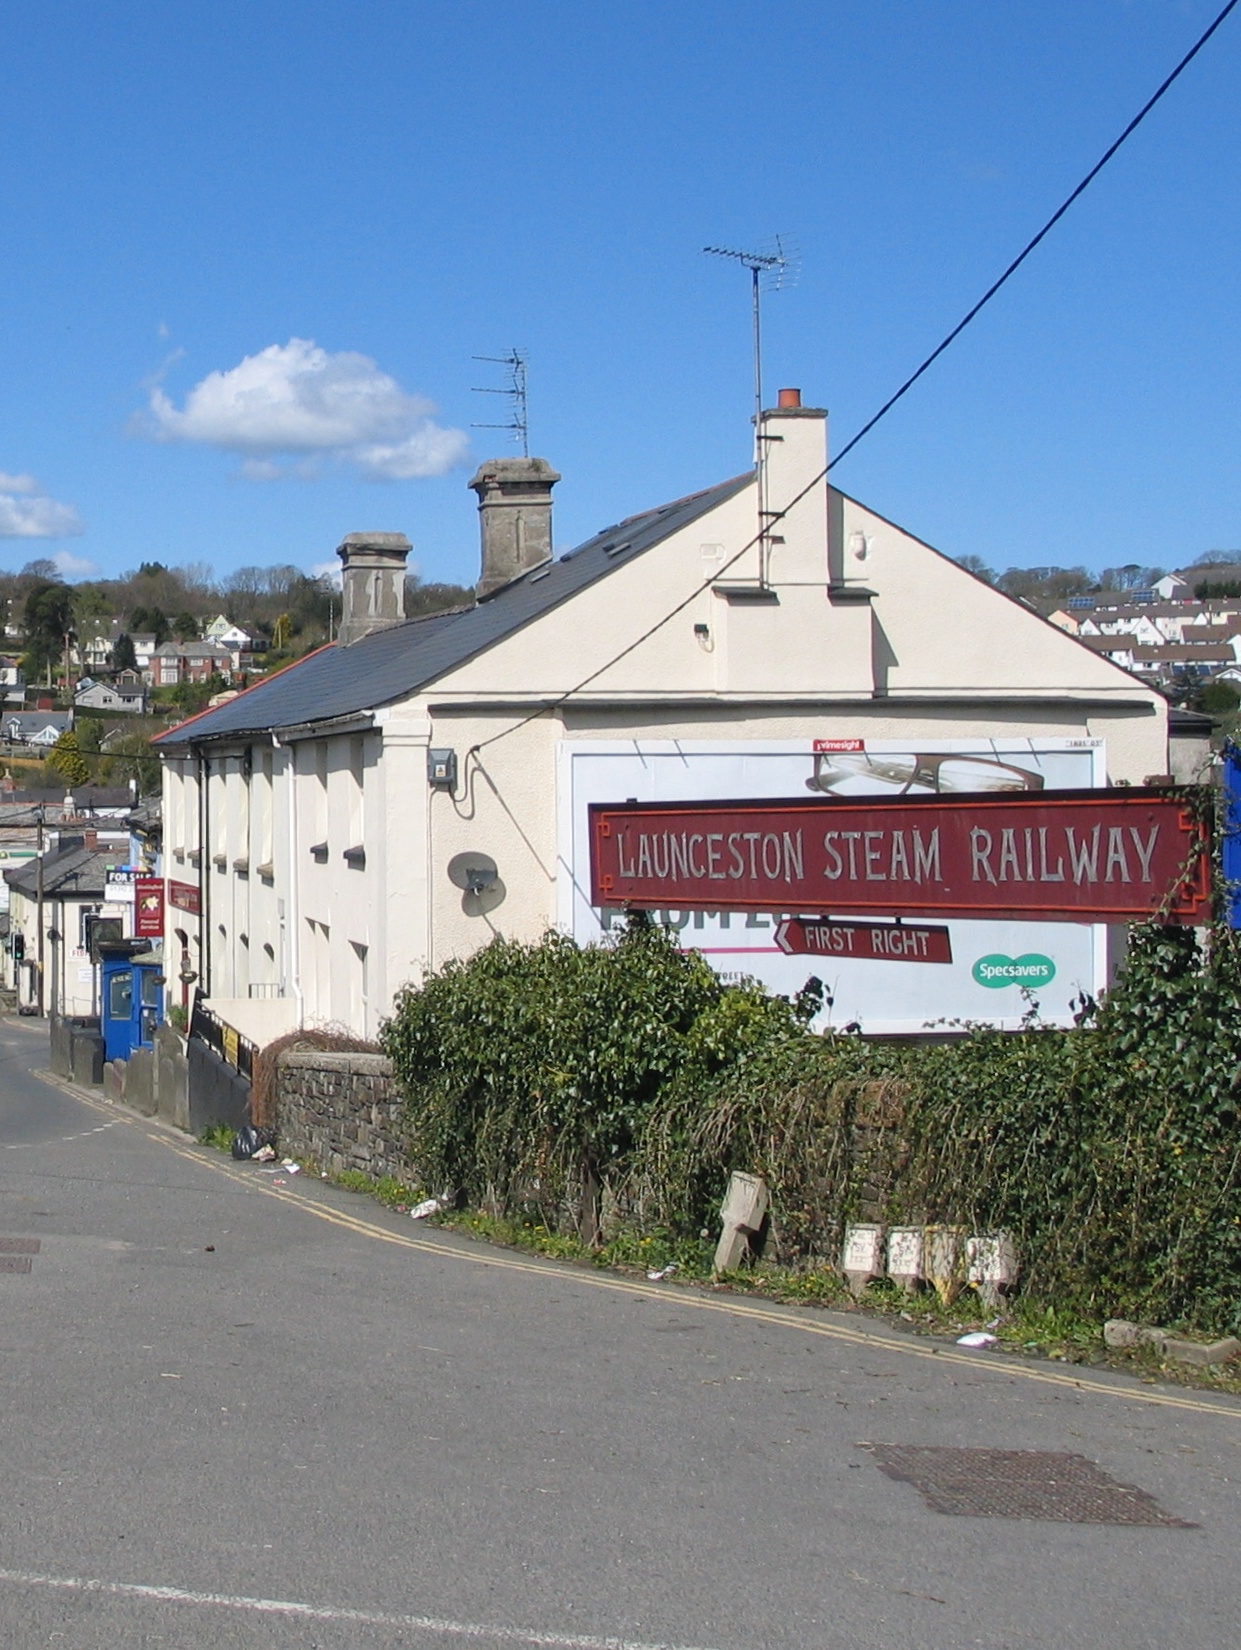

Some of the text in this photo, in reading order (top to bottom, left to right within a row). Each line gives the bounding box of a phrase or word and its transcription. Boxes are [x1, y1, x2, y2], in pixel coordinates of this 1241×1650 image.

[617, 823, 1160, 886] LAUNCESTON STEAM RAILWAY
[109, 872, 128, 882] FOR
[805, 926, 930, 956] FIRST RIGHT
[979, 963, 1049, 978] Specsavers
